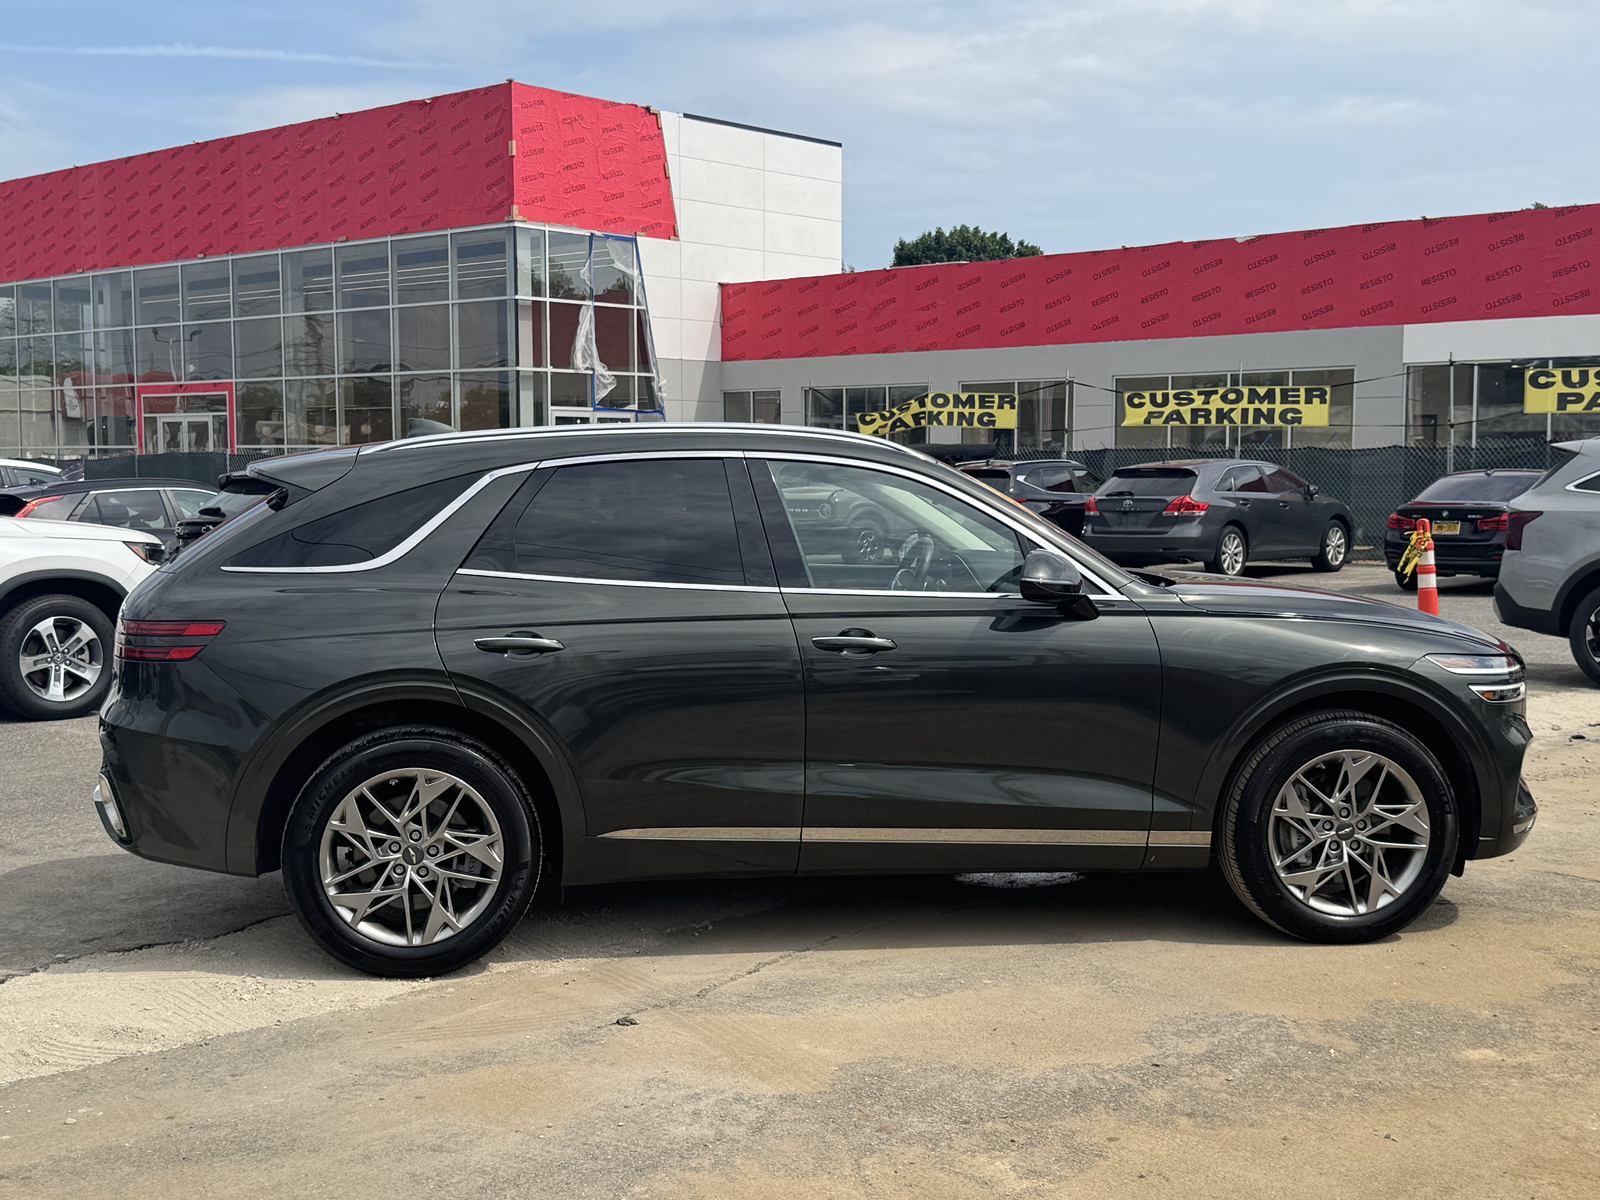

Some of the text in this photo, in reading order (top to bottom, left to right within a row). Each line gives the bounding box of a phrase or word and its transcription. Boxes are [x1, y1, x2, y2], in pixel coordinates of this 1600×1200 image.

[1488, 232, 1525, 251] RESISTO
[1555, 227, 1594, 246] RESISTO
[1362, 242, 1397, 260] RESISTO
[1424, 237, 1459, 256] RESISTO
[1193, 257, 1223, 274] RESISTO
[1247, 253, 1279, 270] RESISTO
[1303, 249, 1337, 266] RESISTO
[1045, 268, 1073, 284] RESISTO
[1093, 264, 1121, 280] RESISTO
[1142, 260, 1171, 277] RESISTO
[1421, 268, 1457, 286] RESISTO
[1485, 264, 1522, 282] RESISTO
[1552, 259, 1591, 279] RESISTO
[957, 275, 982, 290] RESISTO
[1000, 273, 1027, 288] RESISTO
[1301, 277, 1334, 295] RESISTO
[1359, 272, 1394, 290] RESISTO
[1091, 291, 1119, 306] RESISTO
[1140, 287, 1169, 304] RESISTO
[1191, 285, 1222, 302] RESISTO
[1245, 282, 1277, 299] RESISTO
[1552, 288, 1591, 307] RESISTO
[956, 301, 981, 316] RESISTO
[999, 298, 1025, 314] RESISTO
[1044, 294, 1071, 310] RESISTO
[1359, 299, 1394, 317] RESISTO
[1421, 295, 1457, 314] RESISTO
[1485, 292, 1523, 310] RESISTO
[1141, 312, 1170, 328] RESISTO
[1192, 311, 1222, 327] RESISTO
[1245, 307, 1277, 324] RESISTO
[1301, 304, 1335, 321] RESISTO
[956, 324, 981, 338] RESISTO
[1000, 321, 1026, 335] RESISTO
[1045, 317, 1072, 333] RESISTO
[1091, 315, 1120, 331] RESISTO
[1127, 387, 1328, 409] CUSTOMER
[1143, 408, 1304, 426] PARKING
